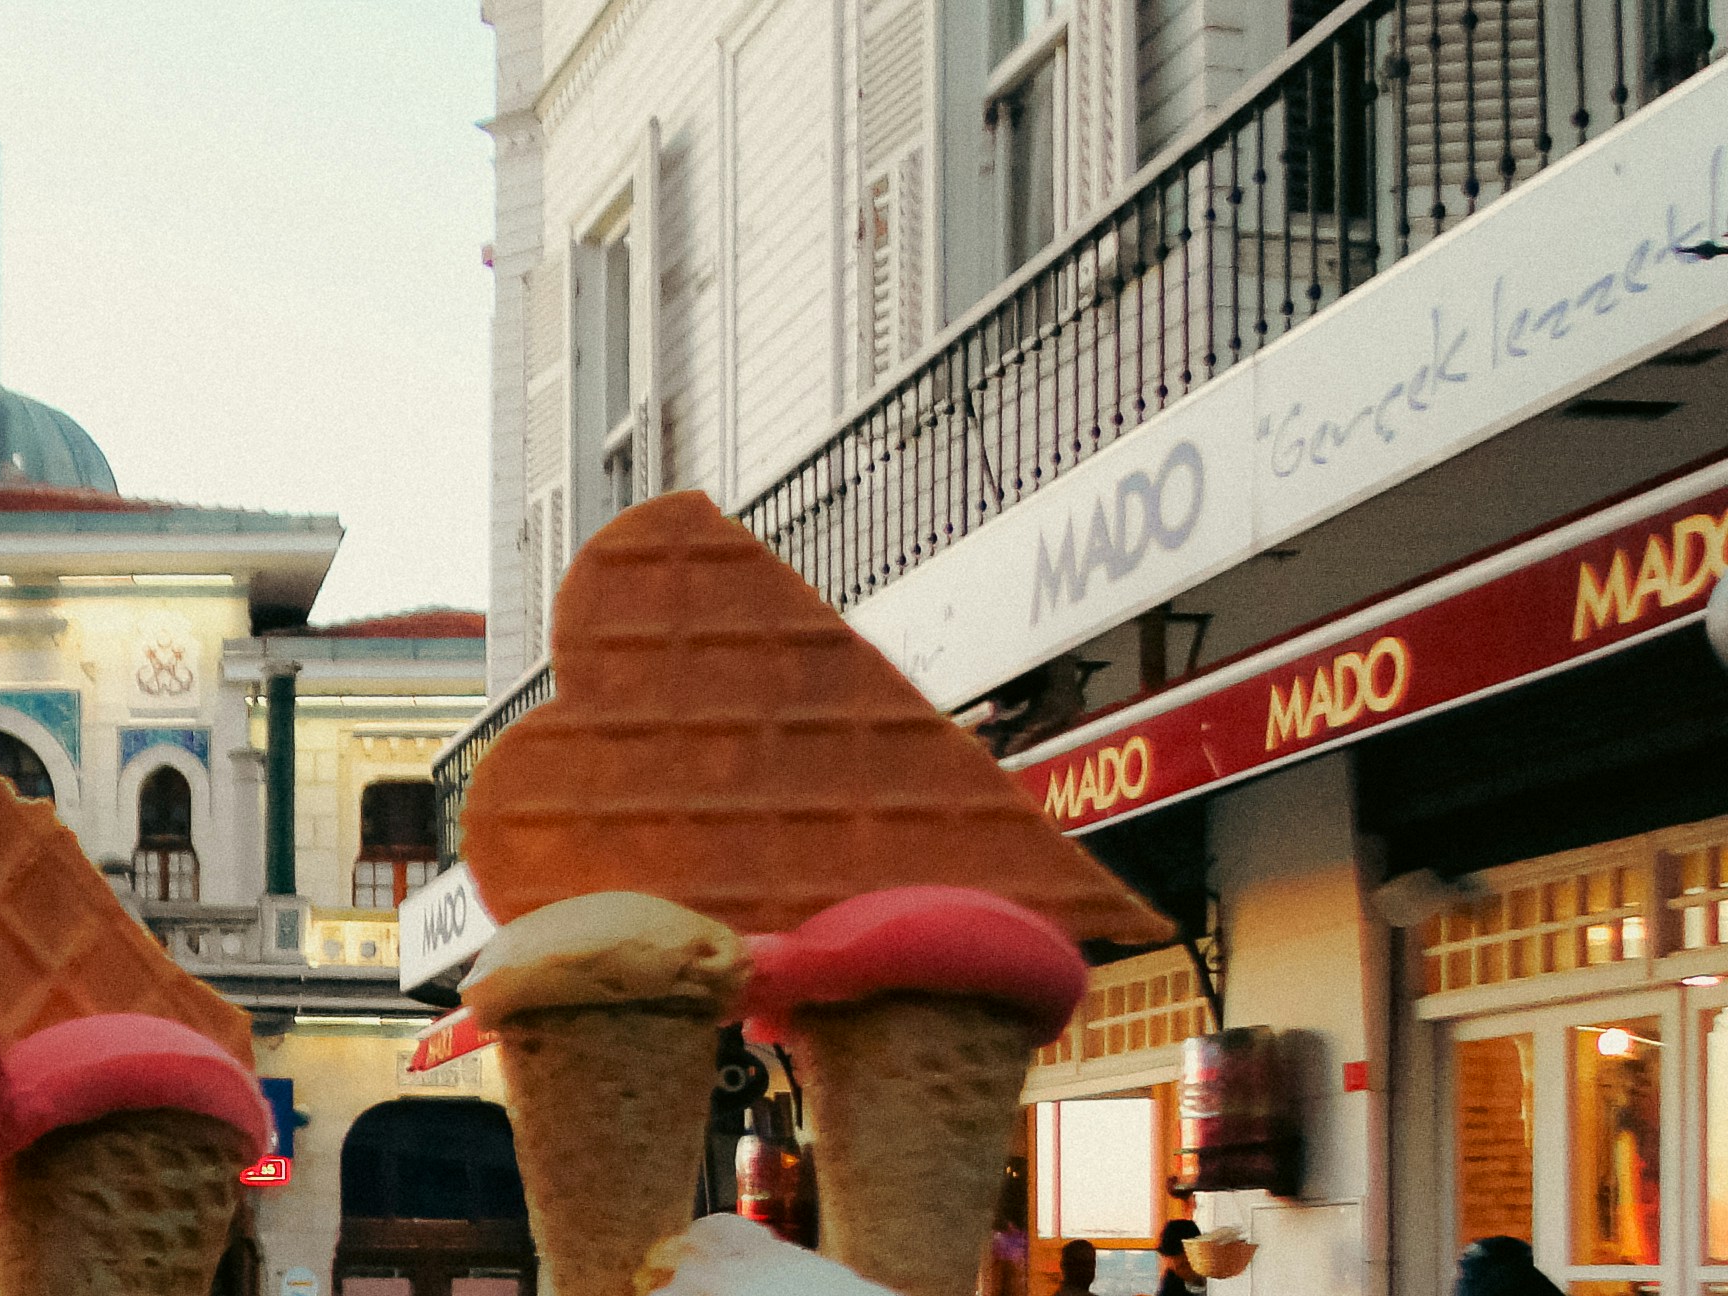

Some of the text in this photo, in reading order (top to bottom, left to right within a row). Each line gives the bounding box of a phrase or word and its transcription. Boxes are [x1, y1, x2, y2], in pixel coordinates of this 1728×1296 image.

[1029, 441, 1204, 628] MADO
[1573, 508, 1728, 642] MAD
[1265, 636, 1410, 751] MADO
[1043, 735, 1151, 820] MADO
[422, 884, 467, 958] MADO
